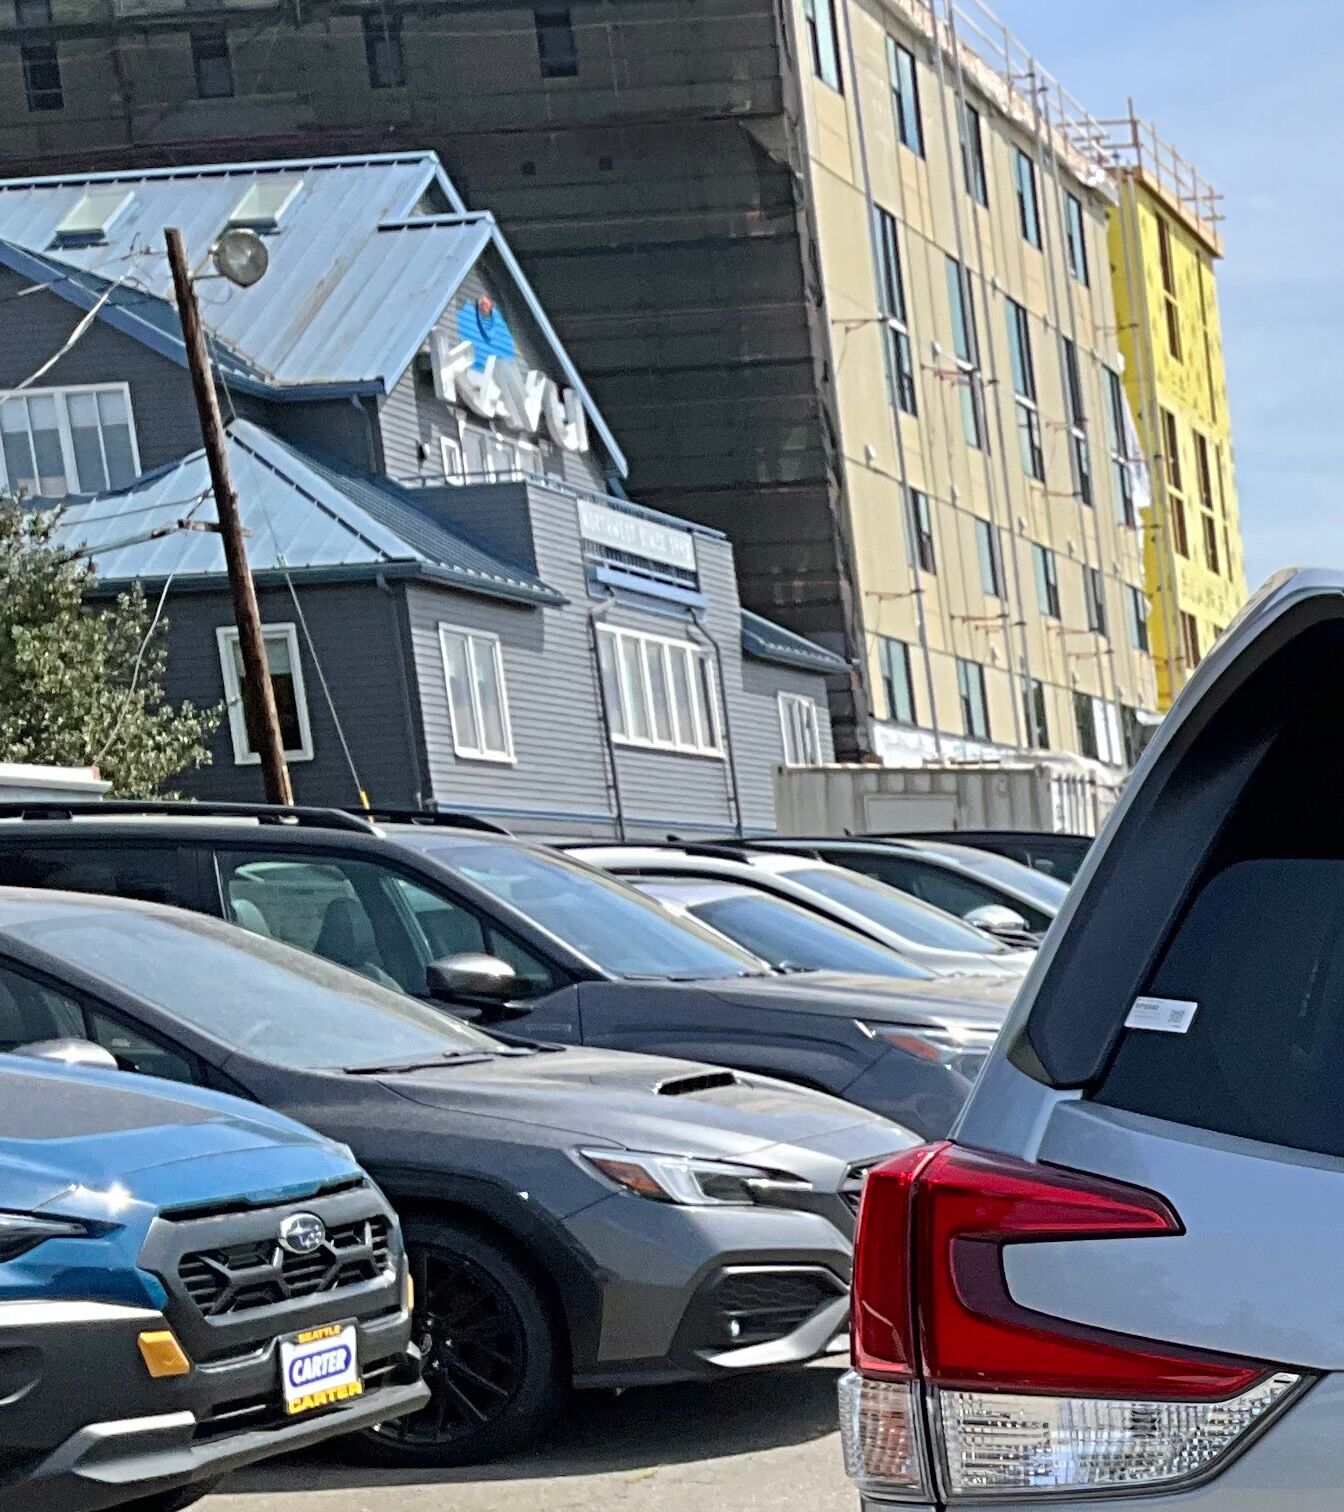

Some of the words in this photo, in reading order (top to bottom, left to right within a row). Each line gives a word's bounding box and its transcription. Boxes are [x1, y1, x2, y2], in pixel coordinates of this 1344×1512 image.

[298, 1324, 341, 1343] SEATTLE
[292, 1348, 348, 1384] CARTER
[287, 1382, 363, 1414] CARTER
